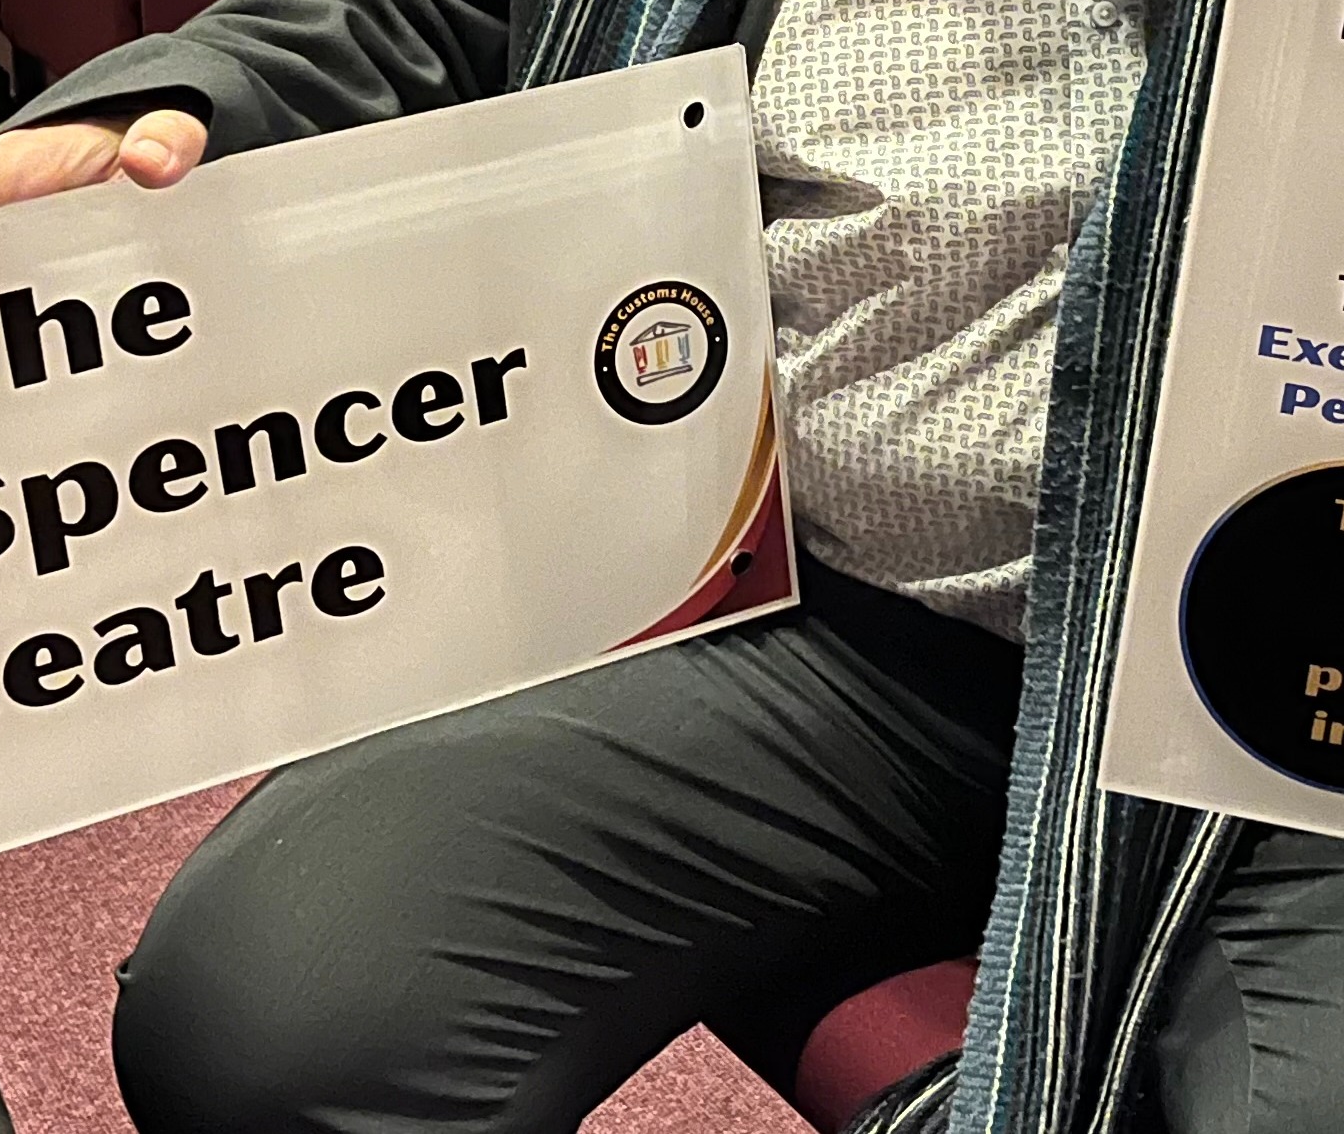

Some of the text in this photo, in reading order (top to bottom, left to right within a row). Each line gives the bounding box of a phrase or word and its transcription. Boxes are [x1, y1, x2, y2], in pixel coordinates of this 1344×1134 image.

[601, 288, 715, 352] The Customs House
